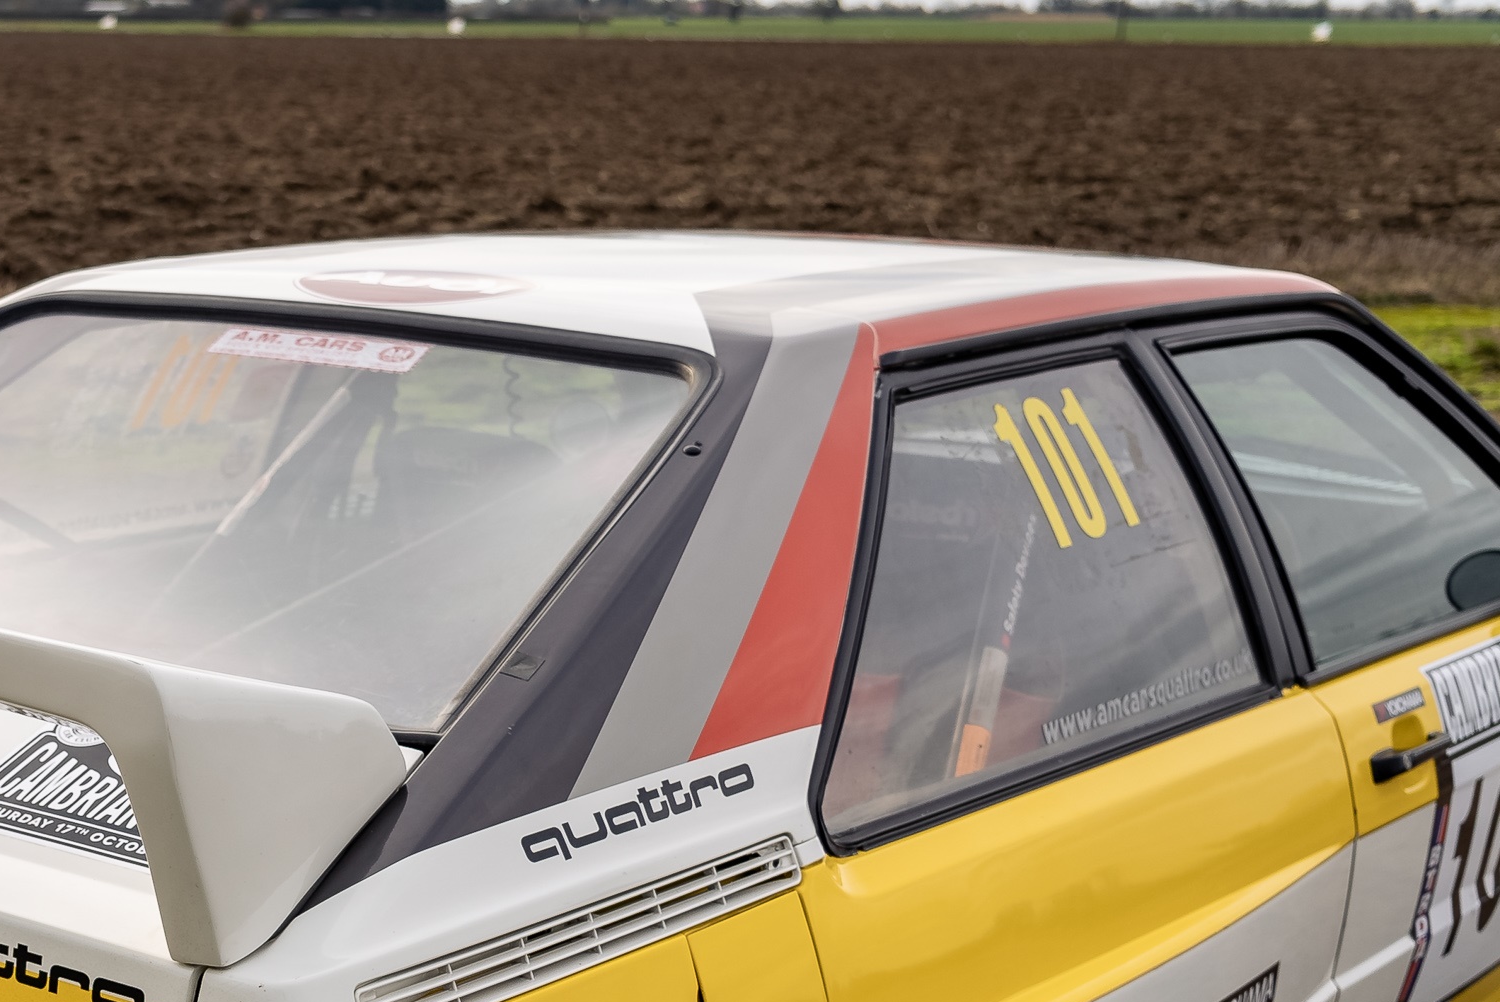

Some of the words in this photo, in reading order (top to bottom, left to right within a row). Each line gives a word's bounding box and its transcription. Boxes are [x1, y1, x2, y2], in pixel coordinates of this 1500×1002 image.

[295, 336, 368, 352] CARS
[994, 388, 1141, 549] 101
[54, 823, 90, 837] 17TH
[520, 763, 754, 863] quattro
